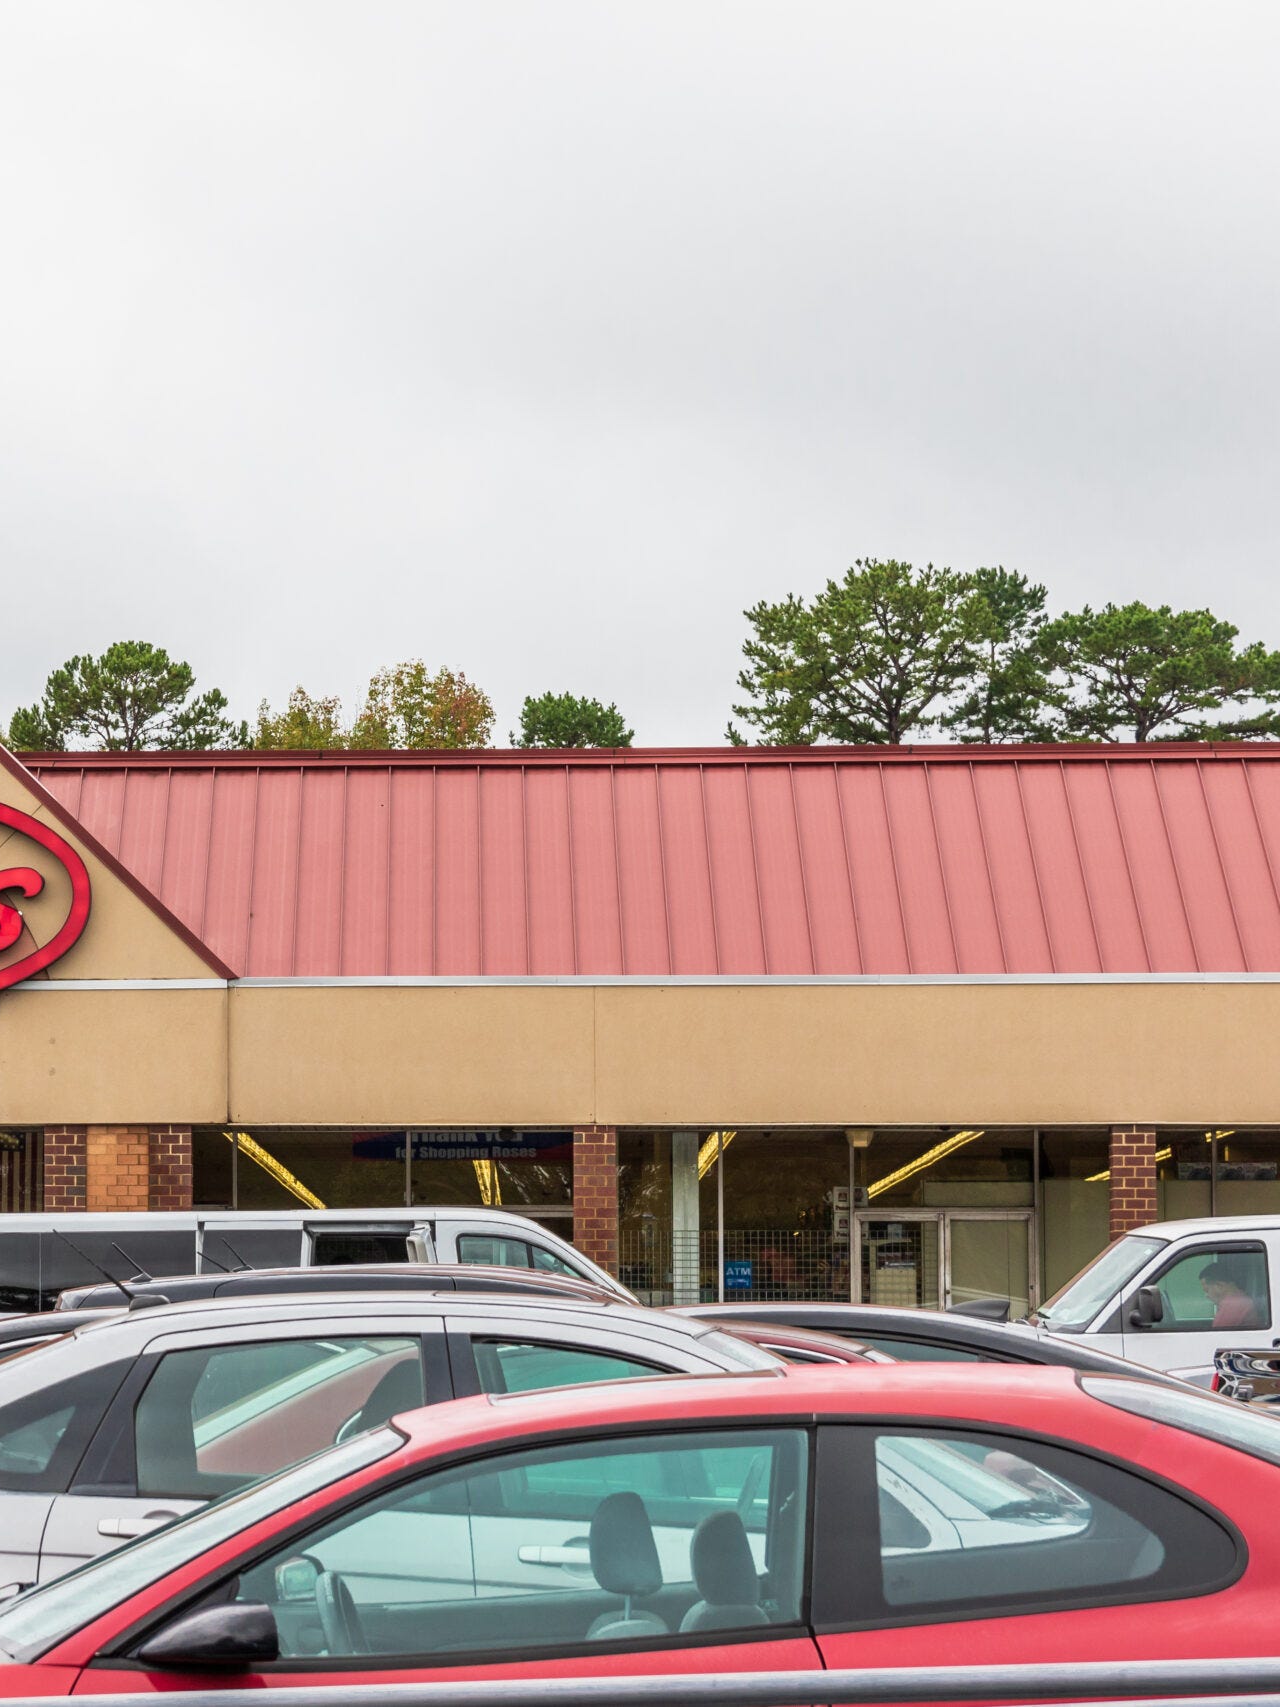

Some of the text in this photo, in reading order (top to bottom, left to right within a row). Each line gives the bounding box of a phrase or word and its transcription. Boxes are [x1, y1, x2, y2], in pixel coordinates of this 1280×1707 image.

[419, 1146, 489, 1159] Shopping
[491, 1147, 537, 1159] Roses
[726, 1267, 751, 1276] ATM
